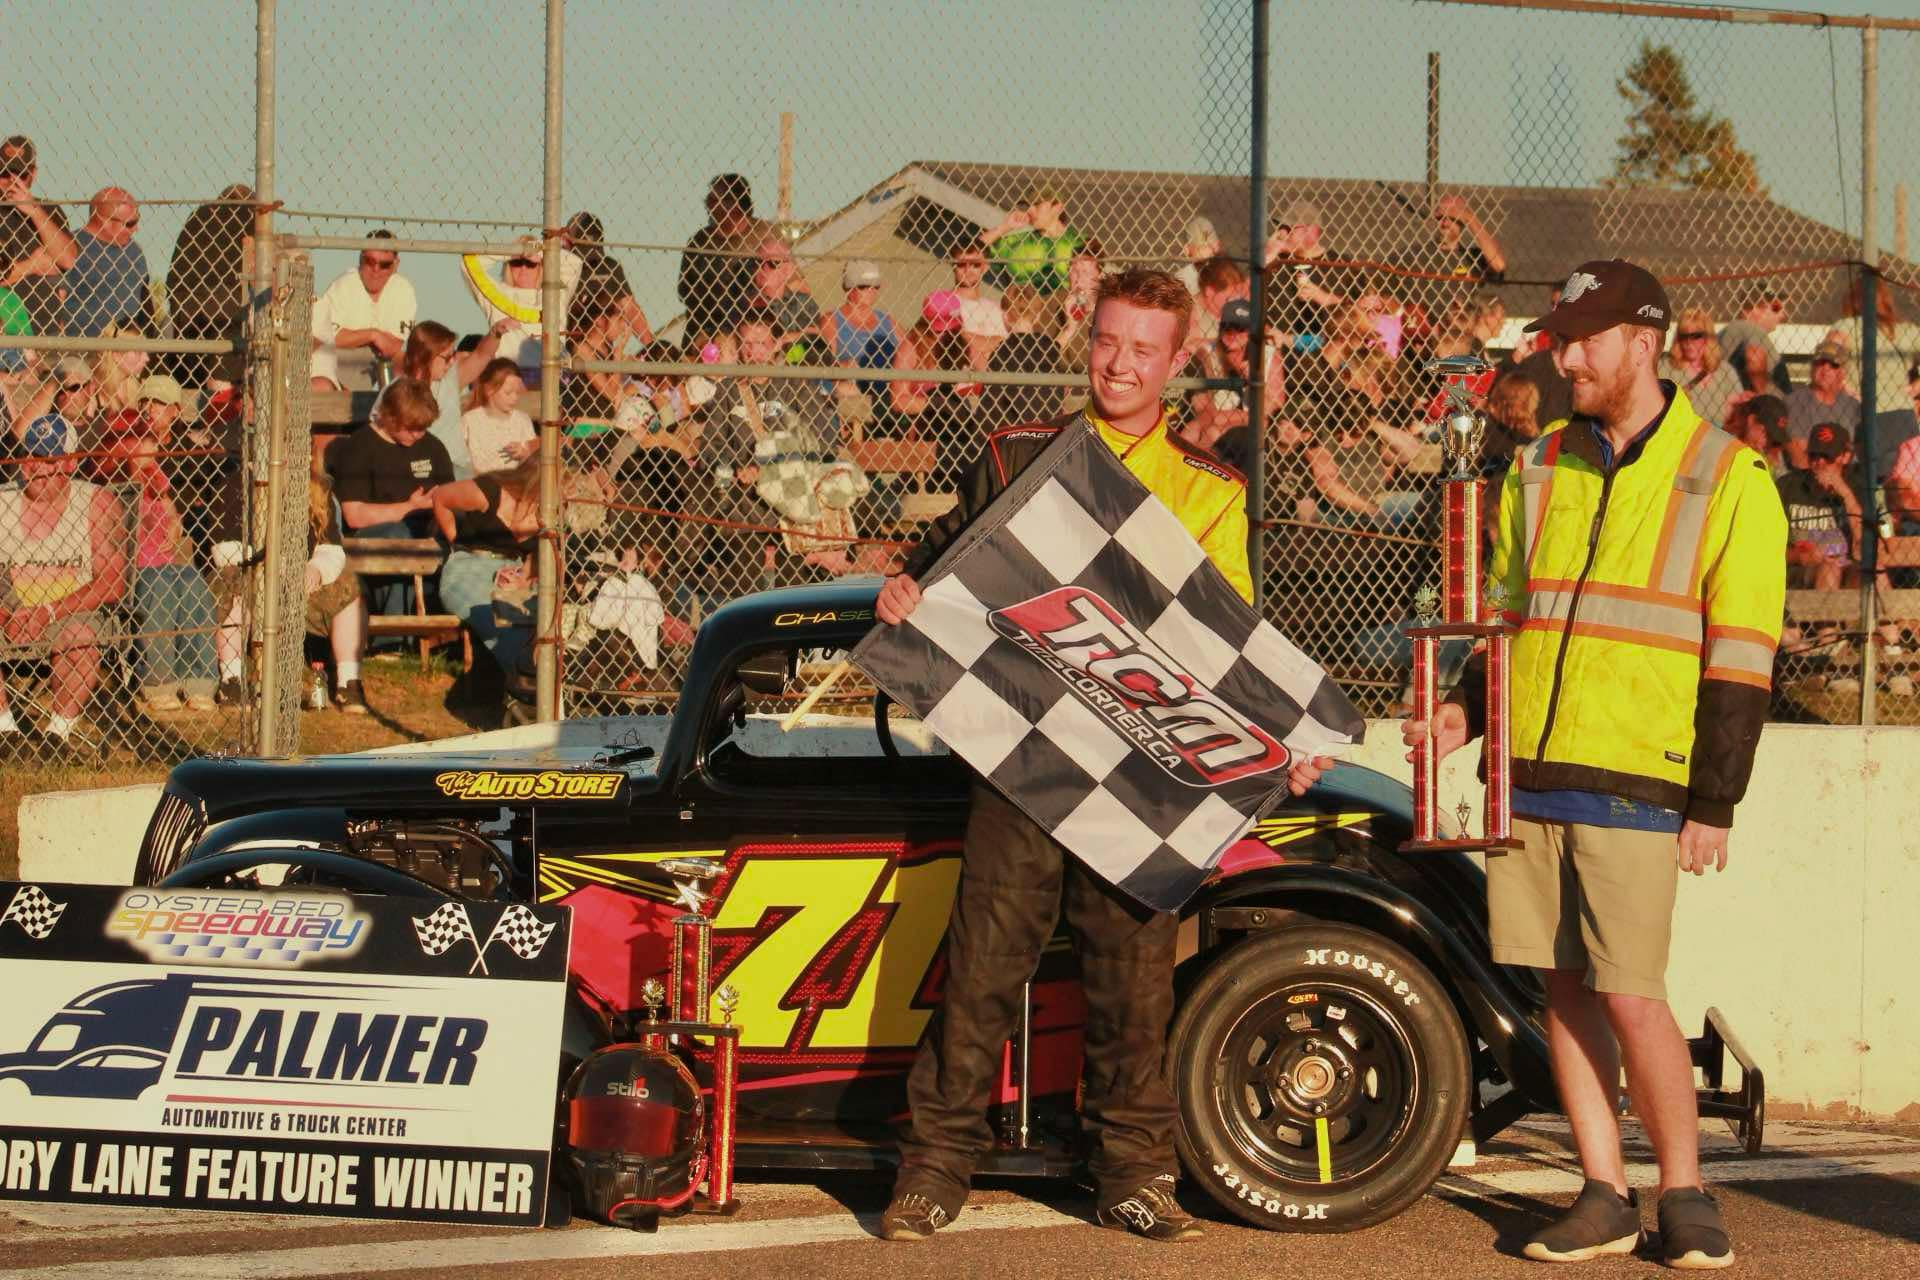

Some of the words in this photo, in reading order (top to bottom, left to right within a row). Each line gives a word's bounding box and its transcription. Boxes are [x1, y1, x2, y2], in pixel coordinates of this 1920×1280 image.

[1007, 431, 1055, 440] IMPACT
[1184, 458, 1230, 480] IMPACT
[774, 609, 873, 626] CHASE
[438, 773, 475, 792] The
[125, 894, 263, 914] OYSTER
[271, 899, 345, 917] BED
[111, 908, 364, 949] speedway
[1303, 948, 1421, 1006] Hoosier
[176, 1005, 488, 1086] PALMER
[606, 1076, 650, 1099] Stilo
[161, 1107, 265, 1130] AUTOMOTIVE
[270, 1113, 281, 1131] &
[287, 1113, 340, 1134] TRUCK
[346, 1116, 407, 1137] CENTER
[70, 1142, 174, 1196] LANE
[184, 1147, 361, 1206] FEATURE
[374, 1155, 534, 1214] WINNER
[1213, 1162, 1331, 1220] Hoosier
